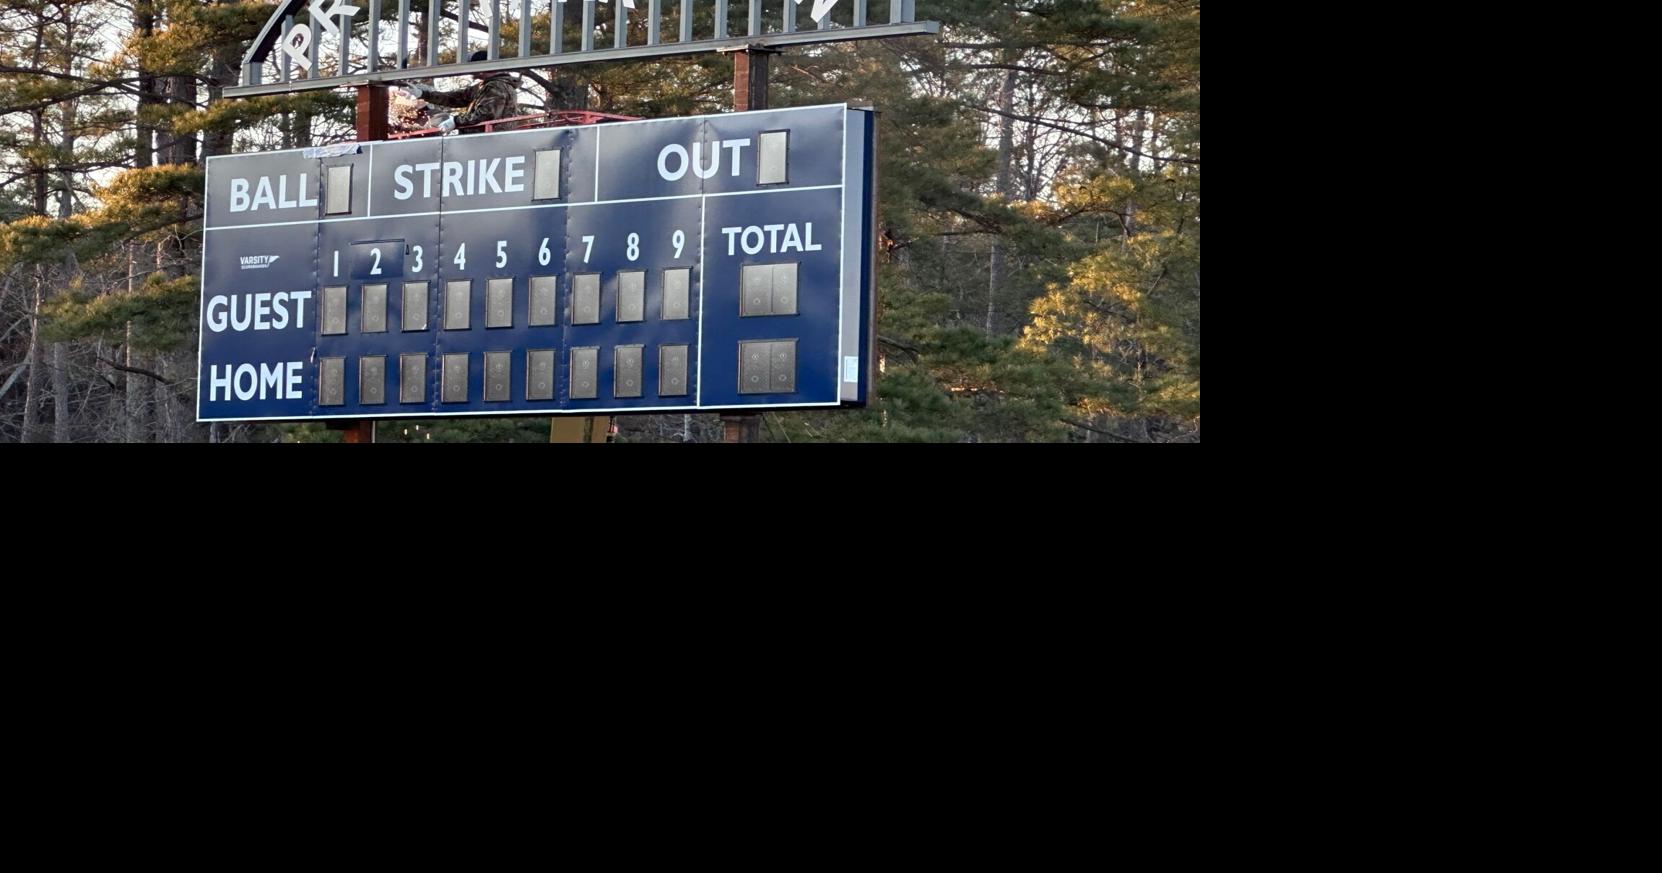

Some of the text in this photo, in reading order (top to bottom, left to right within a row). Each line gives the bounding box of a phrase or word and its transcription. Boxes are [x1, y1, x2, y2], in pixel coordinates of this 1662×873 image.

[393, 155, 526, 201] STRIKE
[656, 138, 751, 182] OUT
[229, 173, 318, 213] BALL
[240, 255, 269, 265] VARSITY
[332, 229, 685, 278] 1 2 3 4 5 6 7 8 9
[721, 222, 822, 256] TOTAL
[206, 290, 312, 333] GUEST
[209, 361, 304, 402] HOME
